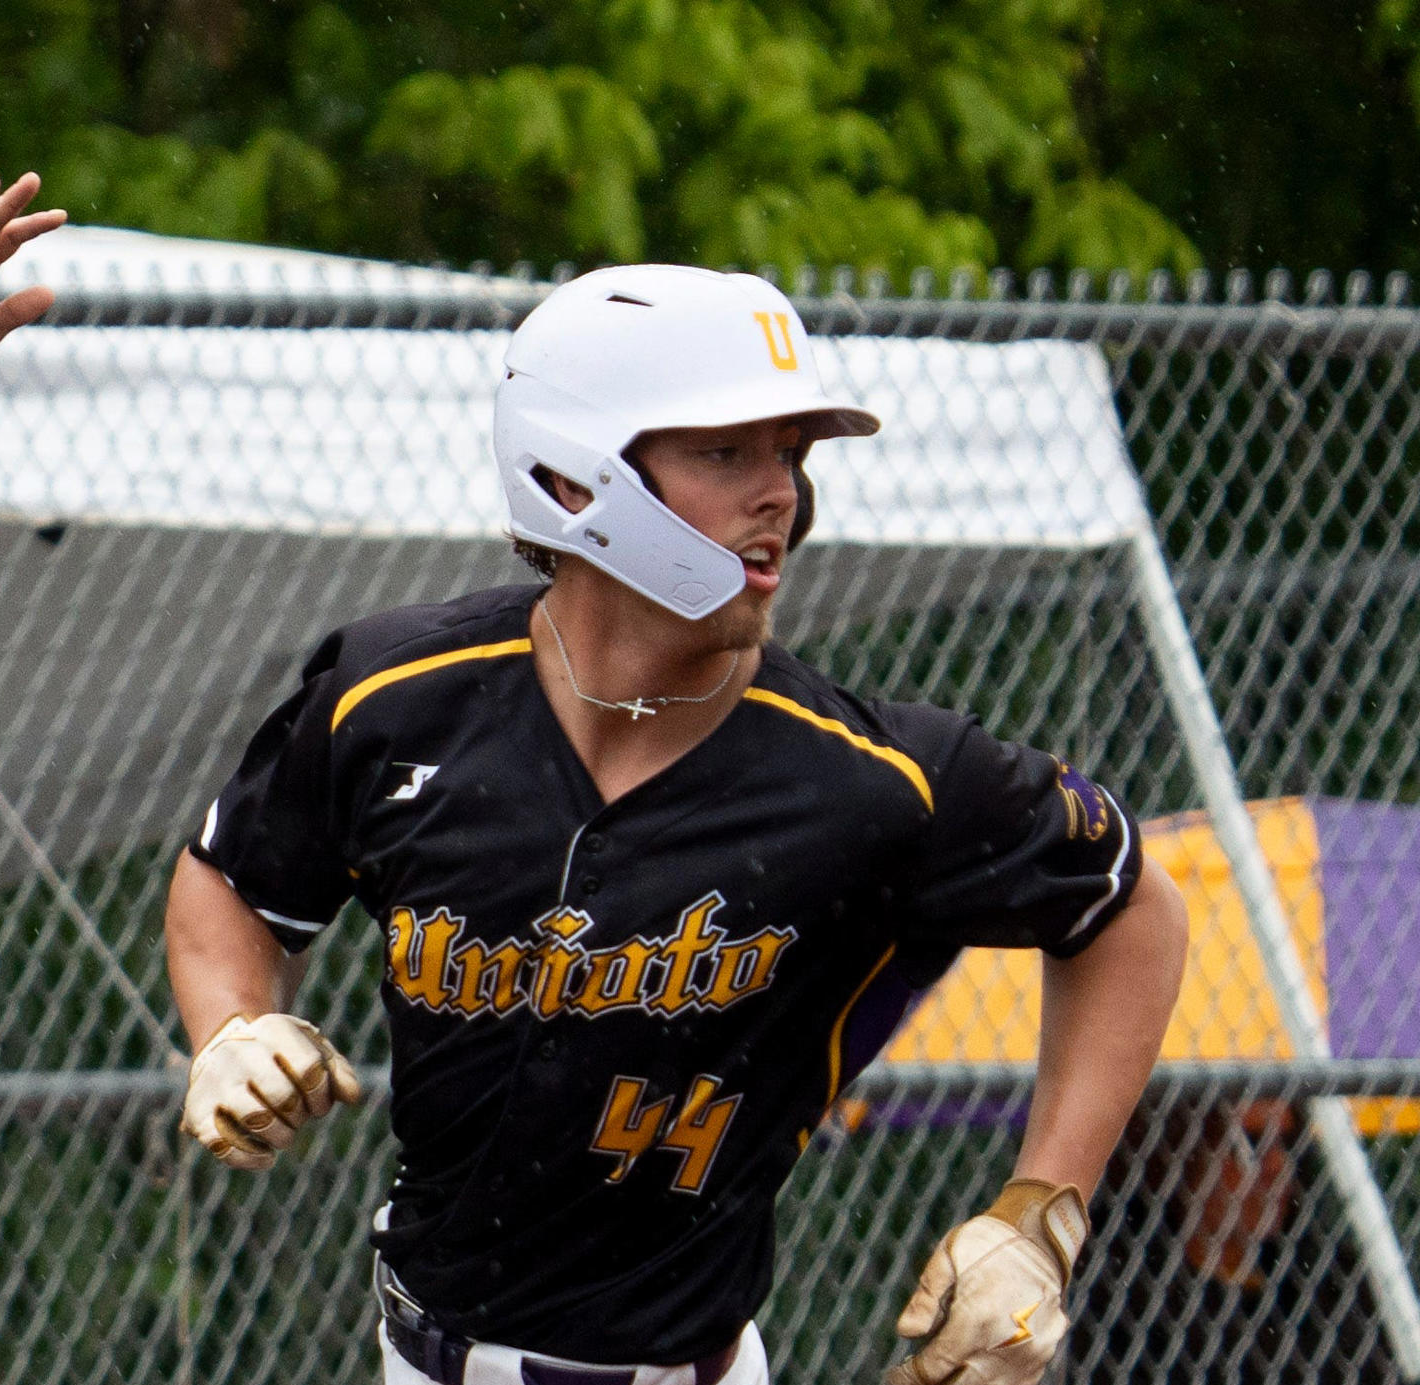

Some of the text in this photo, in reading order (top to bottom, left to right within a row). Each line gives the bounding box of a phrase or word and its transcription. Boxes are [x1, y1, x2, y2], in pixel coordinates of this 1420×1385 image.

[753, 311, 798, 371] U
[387, 890, 799, 1021] Unioto
[590, 1074, 743, 1195] 44
